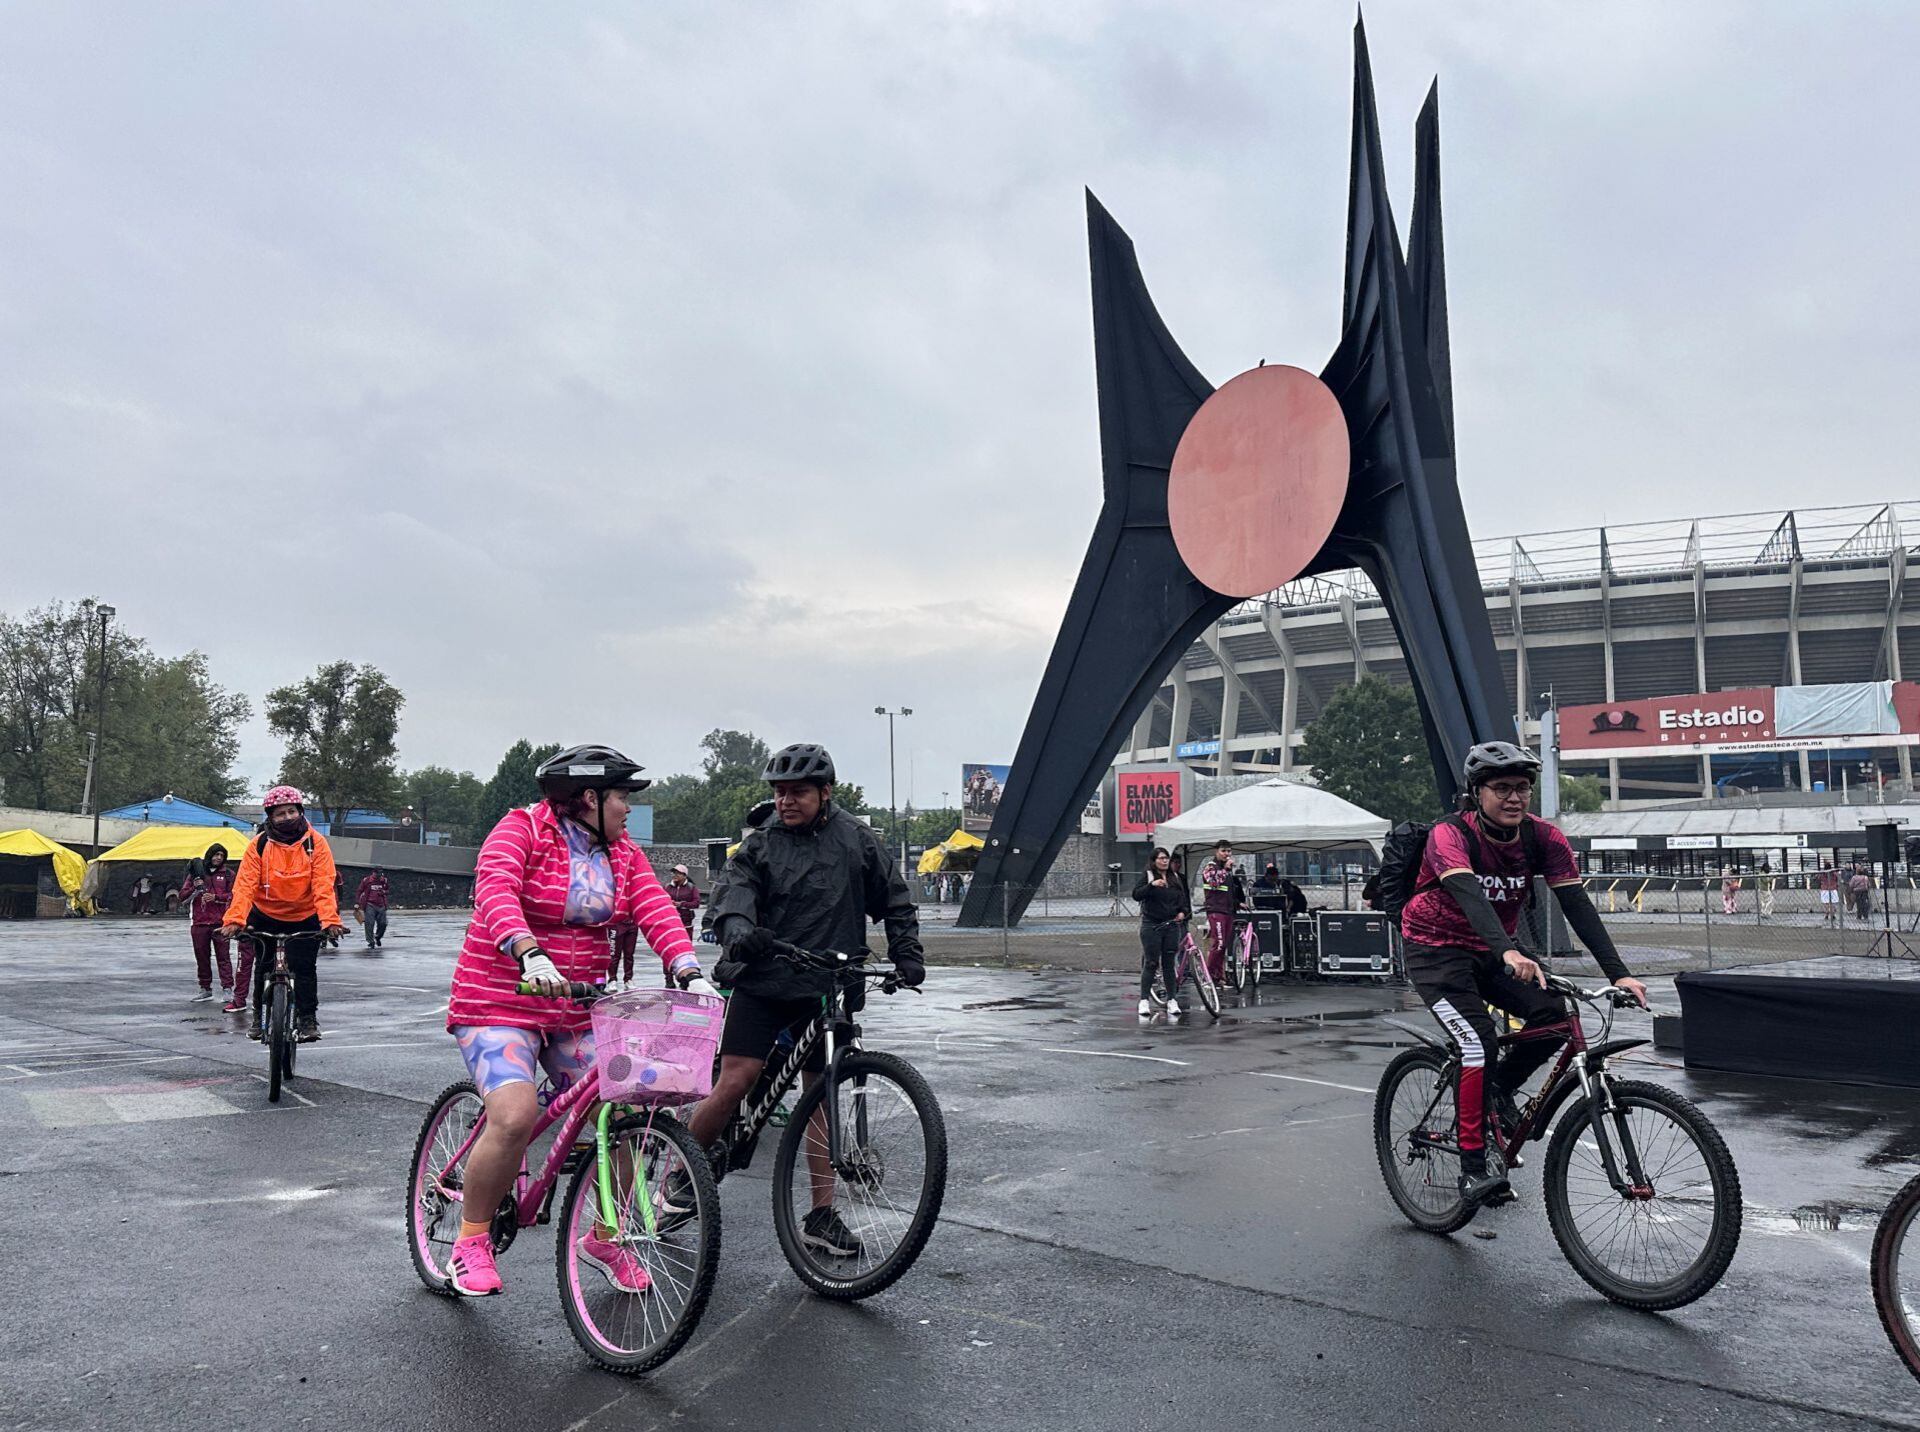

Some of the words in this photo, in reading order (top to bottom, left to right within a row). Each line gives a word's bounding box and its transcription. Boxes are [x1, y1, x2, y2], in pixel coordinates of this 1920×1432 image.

[1659, 706, 1765, 729] Estadio
[1718, 741, 1823, 751] www.estadioazteca.com.mx
[1126, 785, 1140, 799] EL
[1141, 781, 1173, 798] MÁS
[1127, 799, 1173, 824] GRANDE
[1447, 1018, 1464, 1034] JUST
